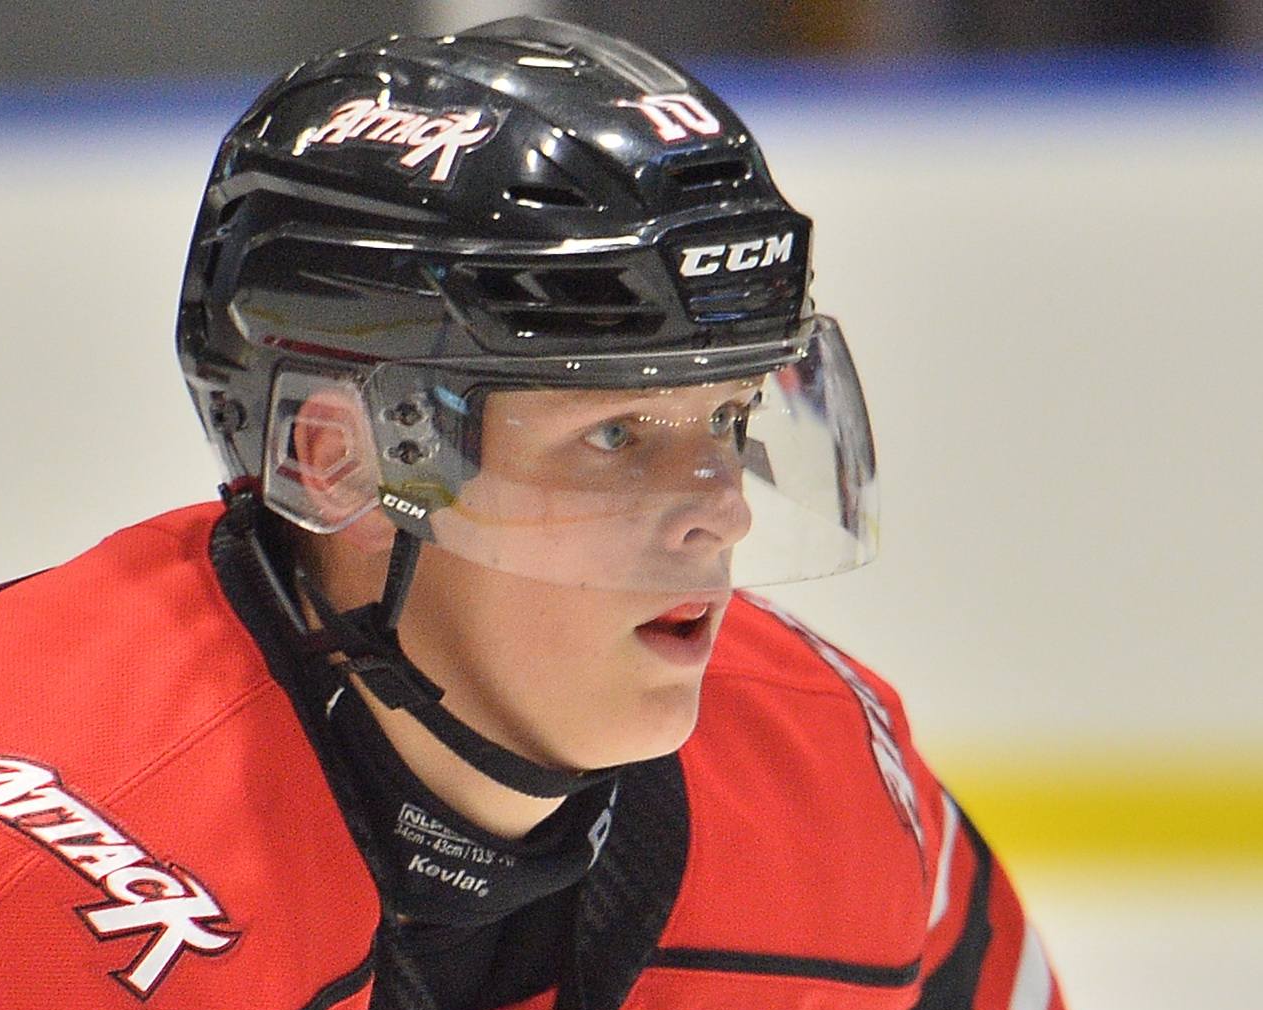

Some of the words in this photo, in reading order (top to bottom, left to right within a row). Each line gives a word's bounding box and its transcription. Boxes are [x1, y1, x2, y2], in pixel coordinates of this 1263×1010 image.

[614, 93, 723, 143] 10
[678, 231, 796, 278] CCM
[381, 492, 428, 521] CCM
